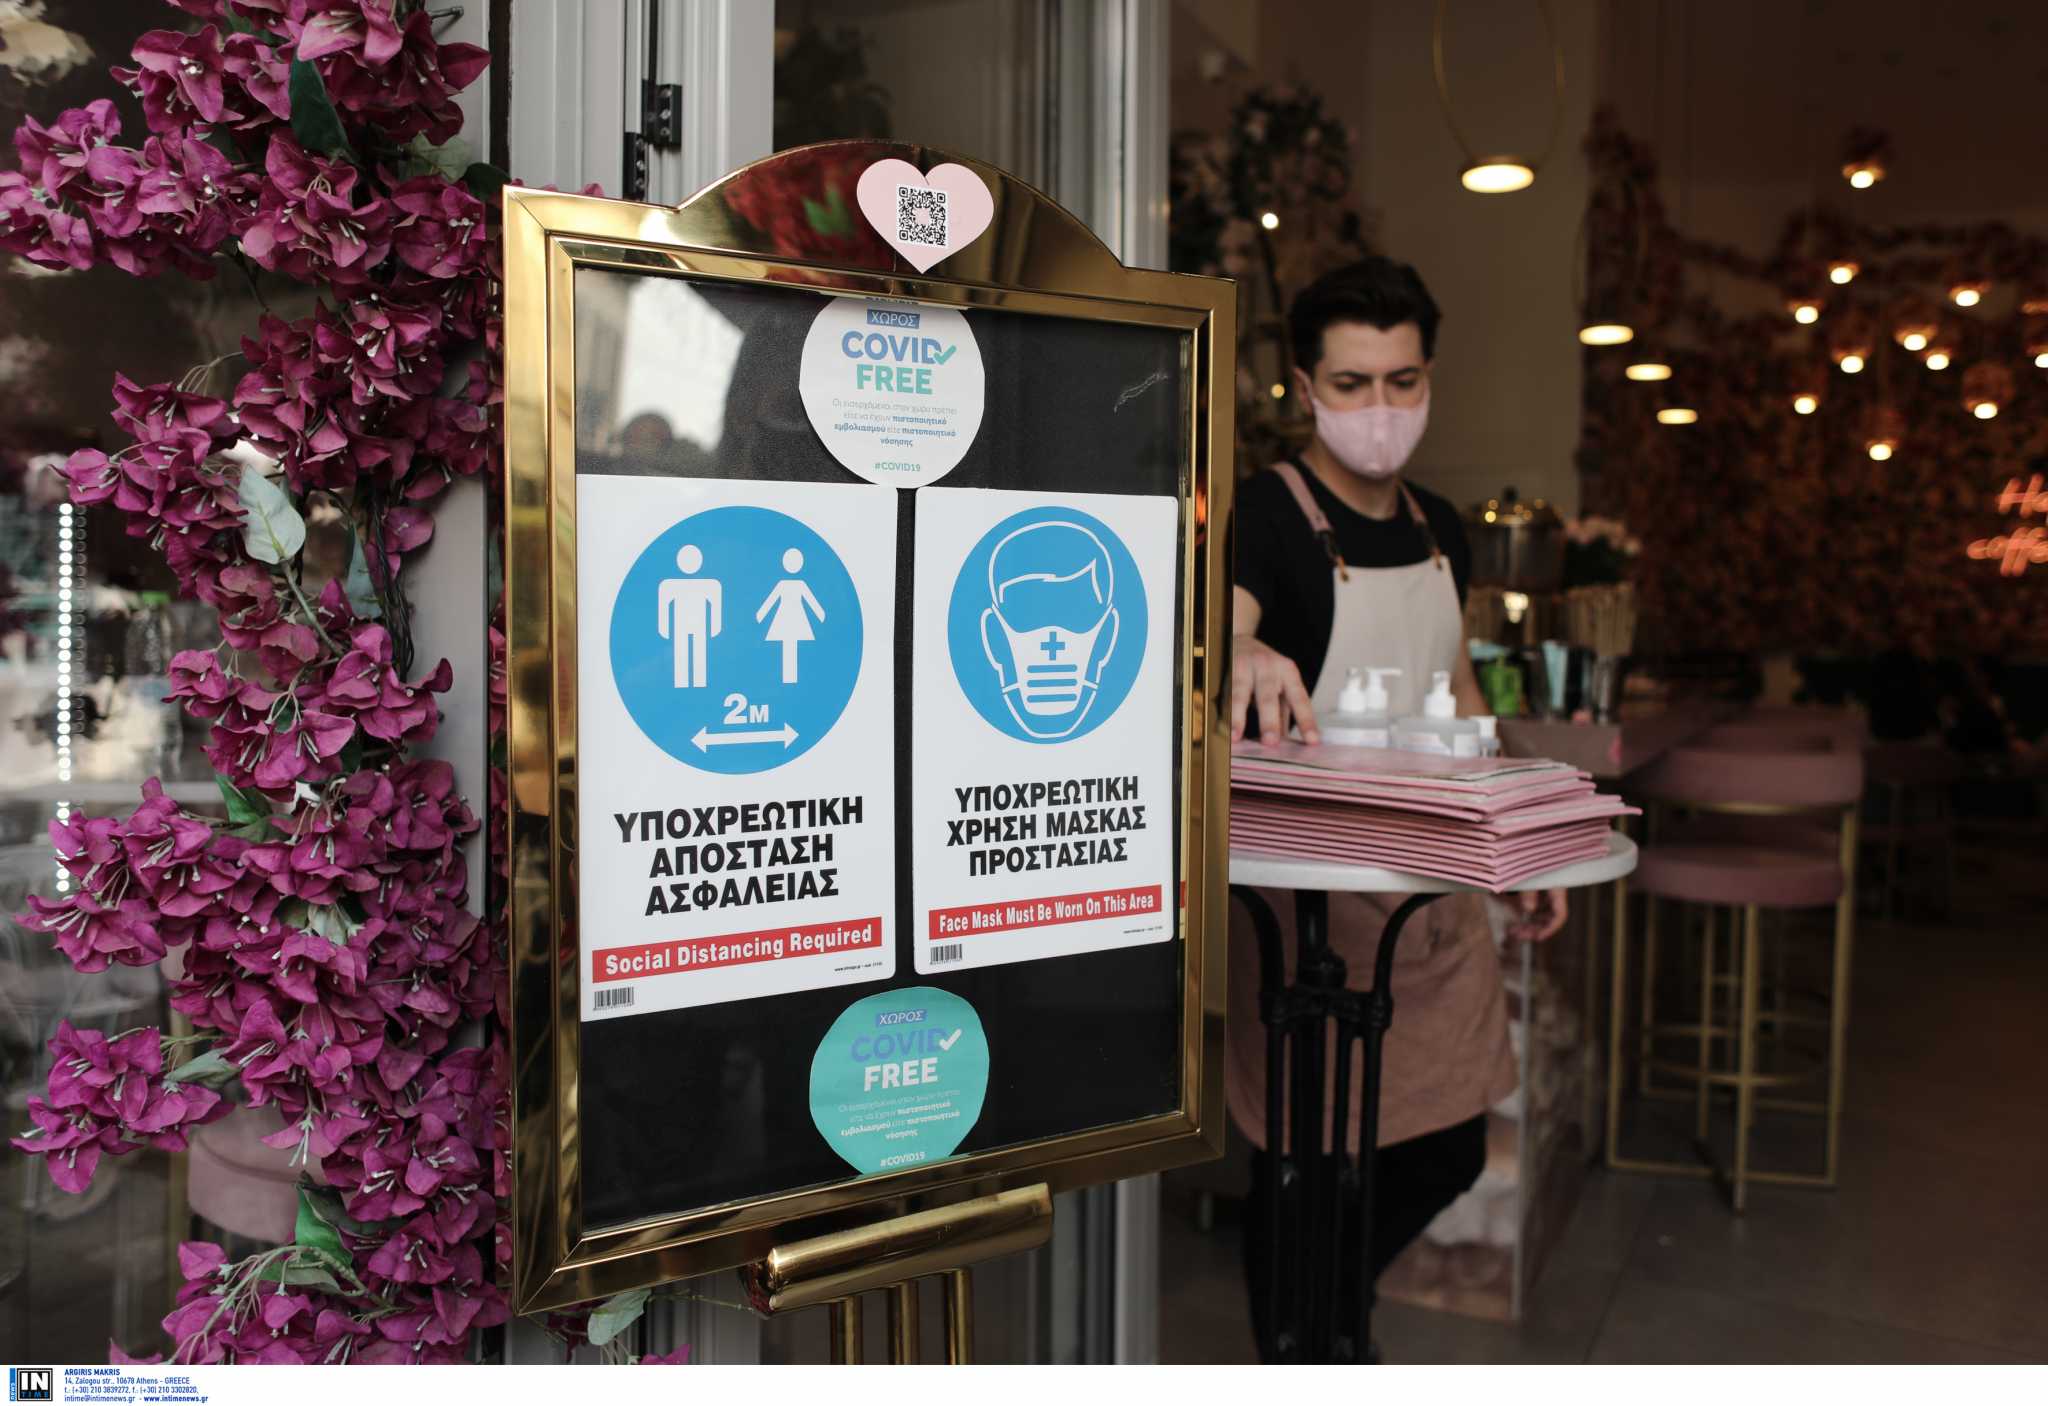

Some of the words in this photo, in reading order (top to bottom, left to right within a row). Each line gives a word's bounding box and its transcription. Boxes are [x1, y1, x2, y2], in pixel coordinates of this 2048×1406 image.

[871, 311, 917, 327] ΧΩΡΟΣ
[841, 330, 942, 364] COVID
[856, 363, 933, 395] FREE
[874, 461, 921, 473] #COVID19
[955, 776, 1139, 813] ΥΠΟΧΡΕΩΤΙΚΗ
[613, 795, 864, 843] ΥΠΟΧΡΕΩΤΙΚΗ
[946, 814, 1037, 847] ΧΡΗΣΗ
[1046, 806, 1147, 837] ΜΑΣΚΑΣ
[649, 833, 834, 878] ΑΠΟΣΤΑΣΗ
[969, 838, 1128, 876] ΠΡΟΣΤΑΣΙΑΣ
[645, 868, 839, 916] ΑΣΦΑΛΕΙΑΣ
[939, 912, 969, 933] Face
[972, 908, 1003, 928] Mask
[1006, 905, 1035, 925] Must
[1038, 904, 1052, 921] Be
[1055, 900, 1083, 918] Worn
[1086, 898, 1100, 915] On
[1103, 894, 1127, 913] This
[1129, 893, 1154, 910] Area
[605, 944, 670, 975] Social
[677, 937, 784, 966] Distancing
[790, 924, 872, 953] Required
[879, 1010, 924, 1025] ΧΩΡΟΣ
[851, 1027, 948, 1062] COVID
[863, 1057, 939, 1092] FREE
[880, 1151, 926, 1167] #COVID19
